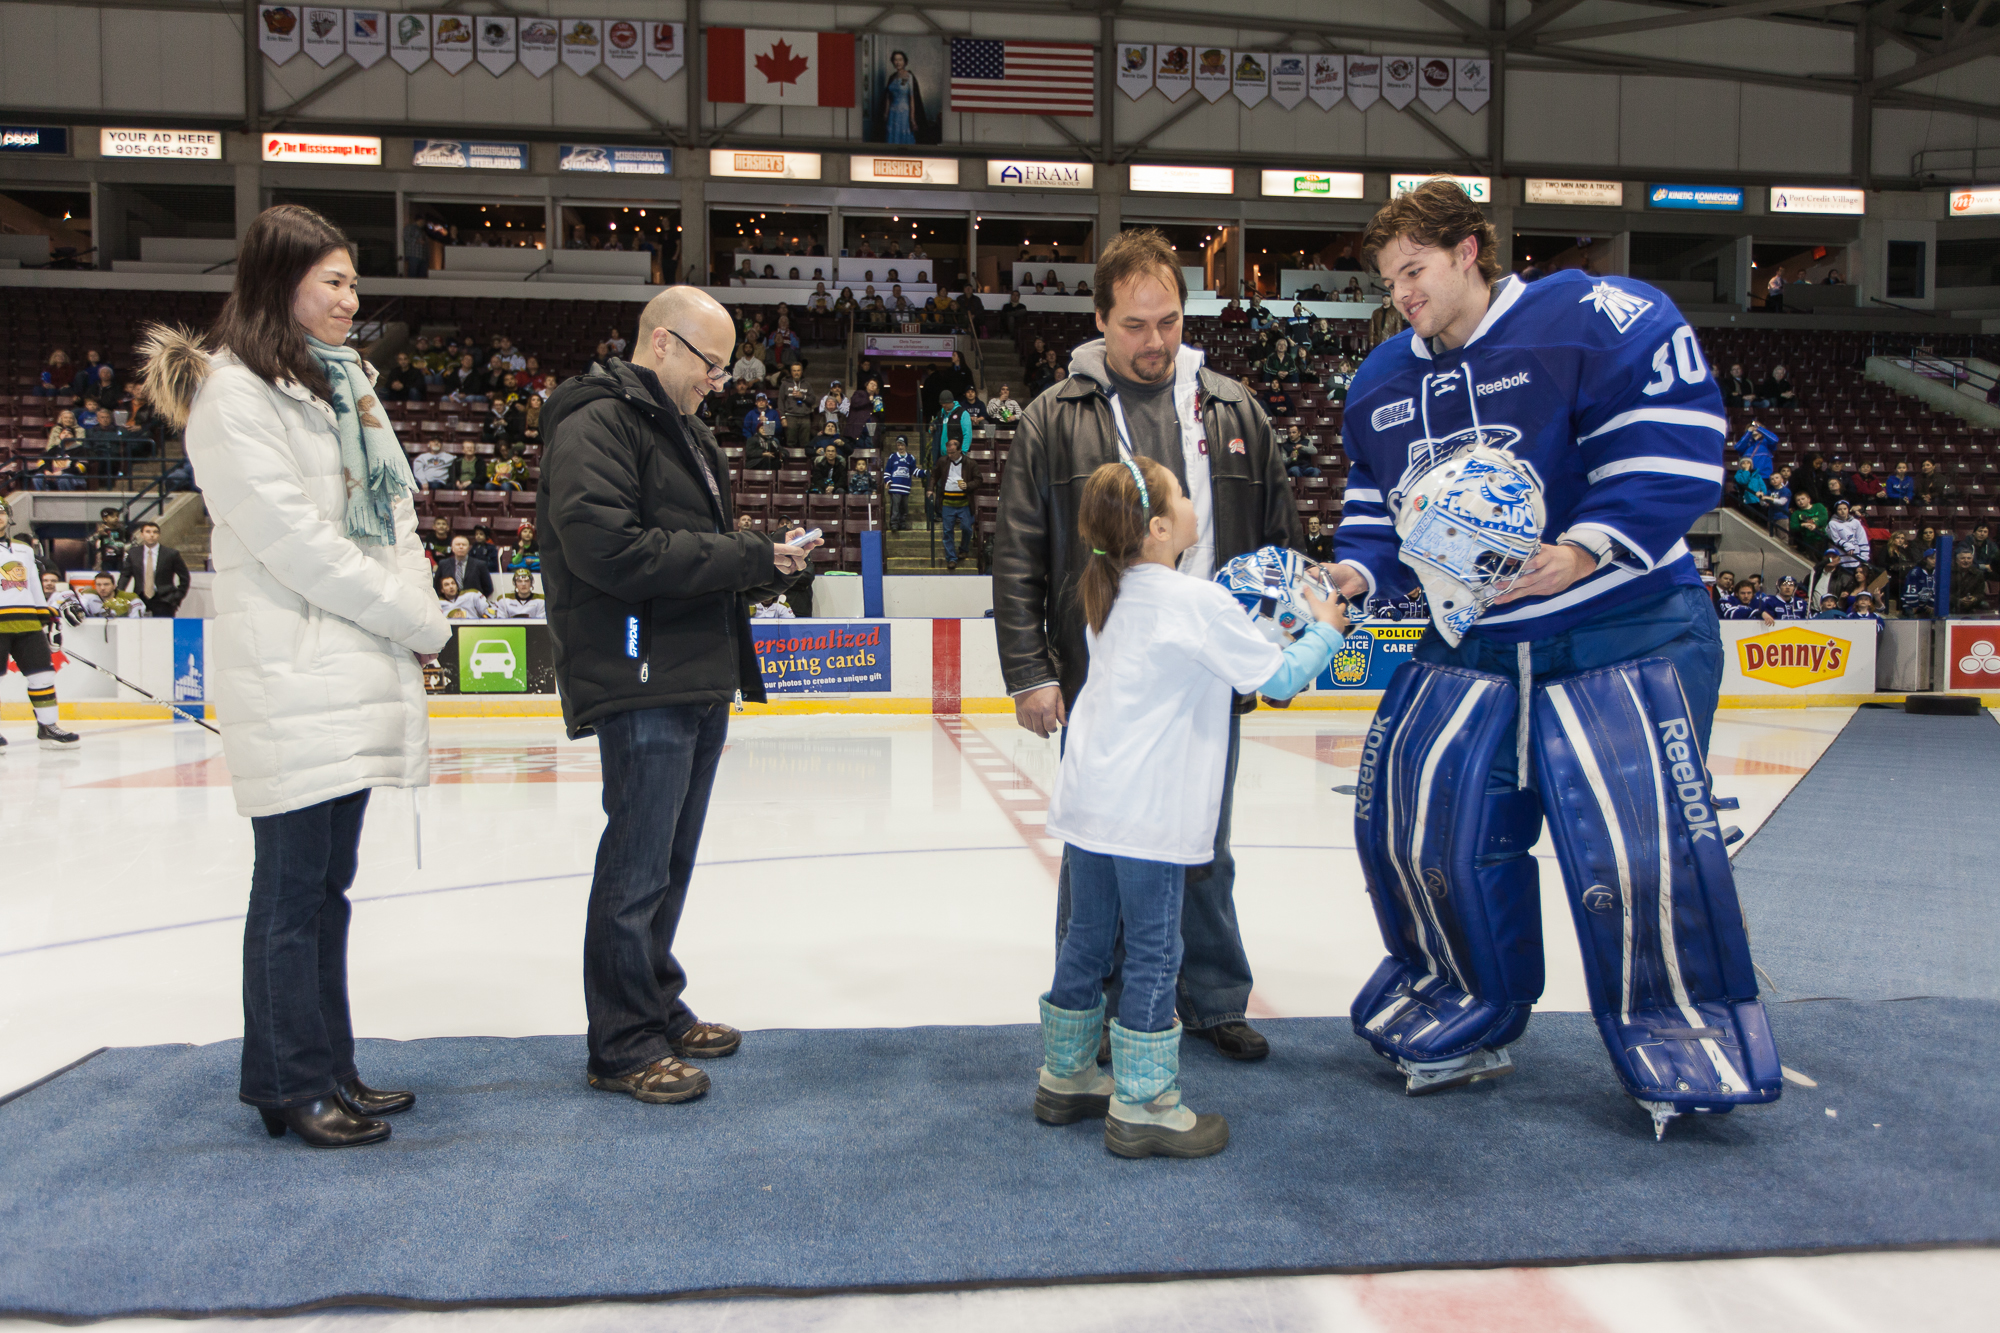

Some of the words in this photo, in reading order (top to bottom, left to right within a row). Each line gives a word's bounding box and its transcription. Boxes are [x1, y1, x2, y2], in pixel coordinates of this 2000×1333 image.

[3, 131, 39, 147] pepsi
[109, 132, 147, 142] YOUR
[153, 133, 171, 143] AD
[178, 134, 215, 145] HERE
[115, 144, 209, 156] 905-615-4373
[283, 142, 297, 153] The
[299, 143, 353, 157] Mississauga
[354, 144, 377, 156] News
[469, 145, 521, 157] MISSISSAUGA
[614, 151, 665, 162] MISSISSAUGA
[469, 157, 521, 169] STEELHEADS
[614, 162, 665, 174] STEELHEADS
[735, 154, 784, 171] HERSHEY'S
[874, 159, 922, 177] HERSHEY'S
[1025, 165, 1079, 181] FRAM
[1397, 180, 1484, 197] SINS
[1668, 191, 1693, 200] KINETIC
[1694, 192, 1738, 201] KONNECTION
[1789, 194, 1805, 202] Port
[1807, 195, 1830, 203] Credit
[1832, 196, 1858, 205] Village
[904, 325, 917, 333] EXIT
[1642, 325, 1707, 396] 30
[1475, 372, 1531, 397] Reebok
[1402, 506, 1437, 551] BAUER
[1906, 584, 1917, 594] 15
[1797, 600, 1803, 610] C
[628, 616, 639, 658] SPYDER
[754, 626, 880, 655] ersonalized
[1378, 629, 1425, 638] POLICIN
[1340, 641, 1369, 650] OLICE
[1383, 643, 1417, 653] CARE
[759, 654, 822, 678] laying
[826, 649, 876, 669] cards
[1744, 639, 1843, 673] Denny's
[778, 679, 802, 689] photos
[812, 676, 836, 685] create
[843, 675, 868, 684] unique
[869, 672, 882, 681] gift
[1355, 715, 1392, 821] Reebok
[1658, 717, 1718, 843] Reebok
